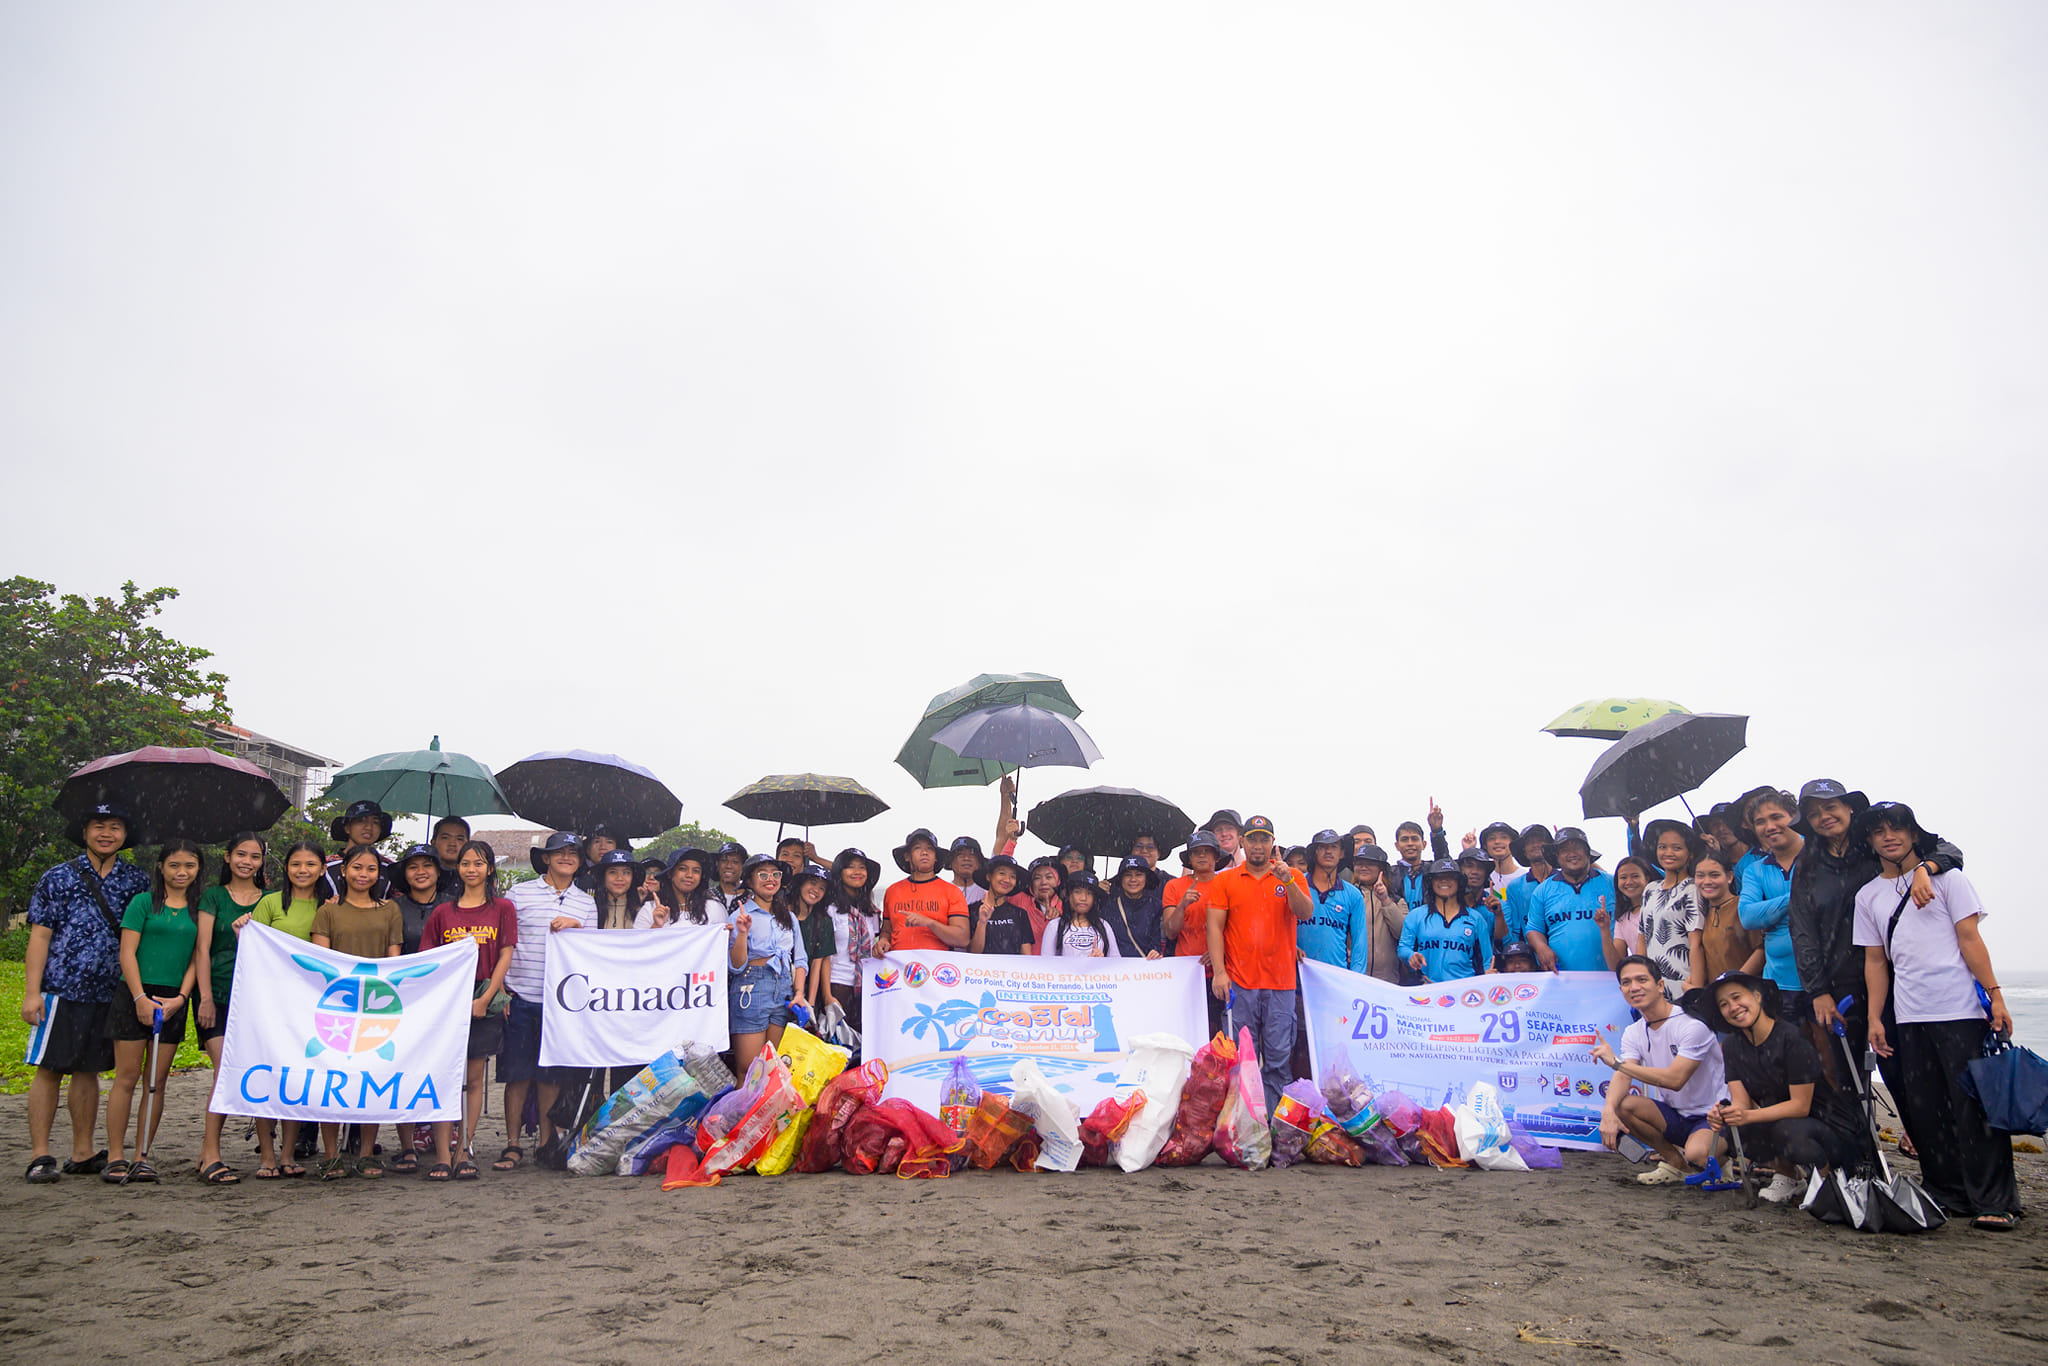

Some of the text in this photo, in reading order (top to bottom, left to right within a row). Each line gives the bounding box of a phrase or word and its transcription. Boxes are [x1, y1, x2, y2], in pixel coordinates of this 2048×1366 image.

[916, 899, 940, 912] GUARD
[1319, 916, 1345, 931] JUAN
[1548, 911, 1571, 925] SAN
[443, 926, 467, 943] SAN
[469, 925, 498, 940] JUAN
[1418, 939, 1440, 951] SAN
[965, 967, 1173, 982] COAST GUARD STATION LA UNION
[964, 976, 982, 985] Poro
[1006, 979, 1021, 990] City
[1023, 980, 1030, 989] of
[1031, 982, 1046, 990] San
[1085, 983, 1095, 991] La
[1096, 982, 1118, 991] Union
[555, 972, 716, 1012] Canada
[999, 991, 1109, 1001] INTERNATIONAL
[1395, 1013, 1433, 1023] NATIONAL
[1525, 1010, 1563, 1022] NATIONAL
[1396, 1019, 1456, 1033] MARITIME
[1396, 1026, 1425, 1038] WEEK
[1528, 1032, 1549, 1043] DAY
[1363, 1041, 1418, 1051] MARINONG
[1468, 1046, 1504, 1056] LIGTAS
[1504, 1048, 1519, 1057] NA
[1409, 1052, 1457, 1061] NAVIGATING
[1509, 1058, 1540, 1067] SAFETY
[1541, 1060, 1563, 1069] FIRST
[240, 1063, 442, 1110] CURMA
